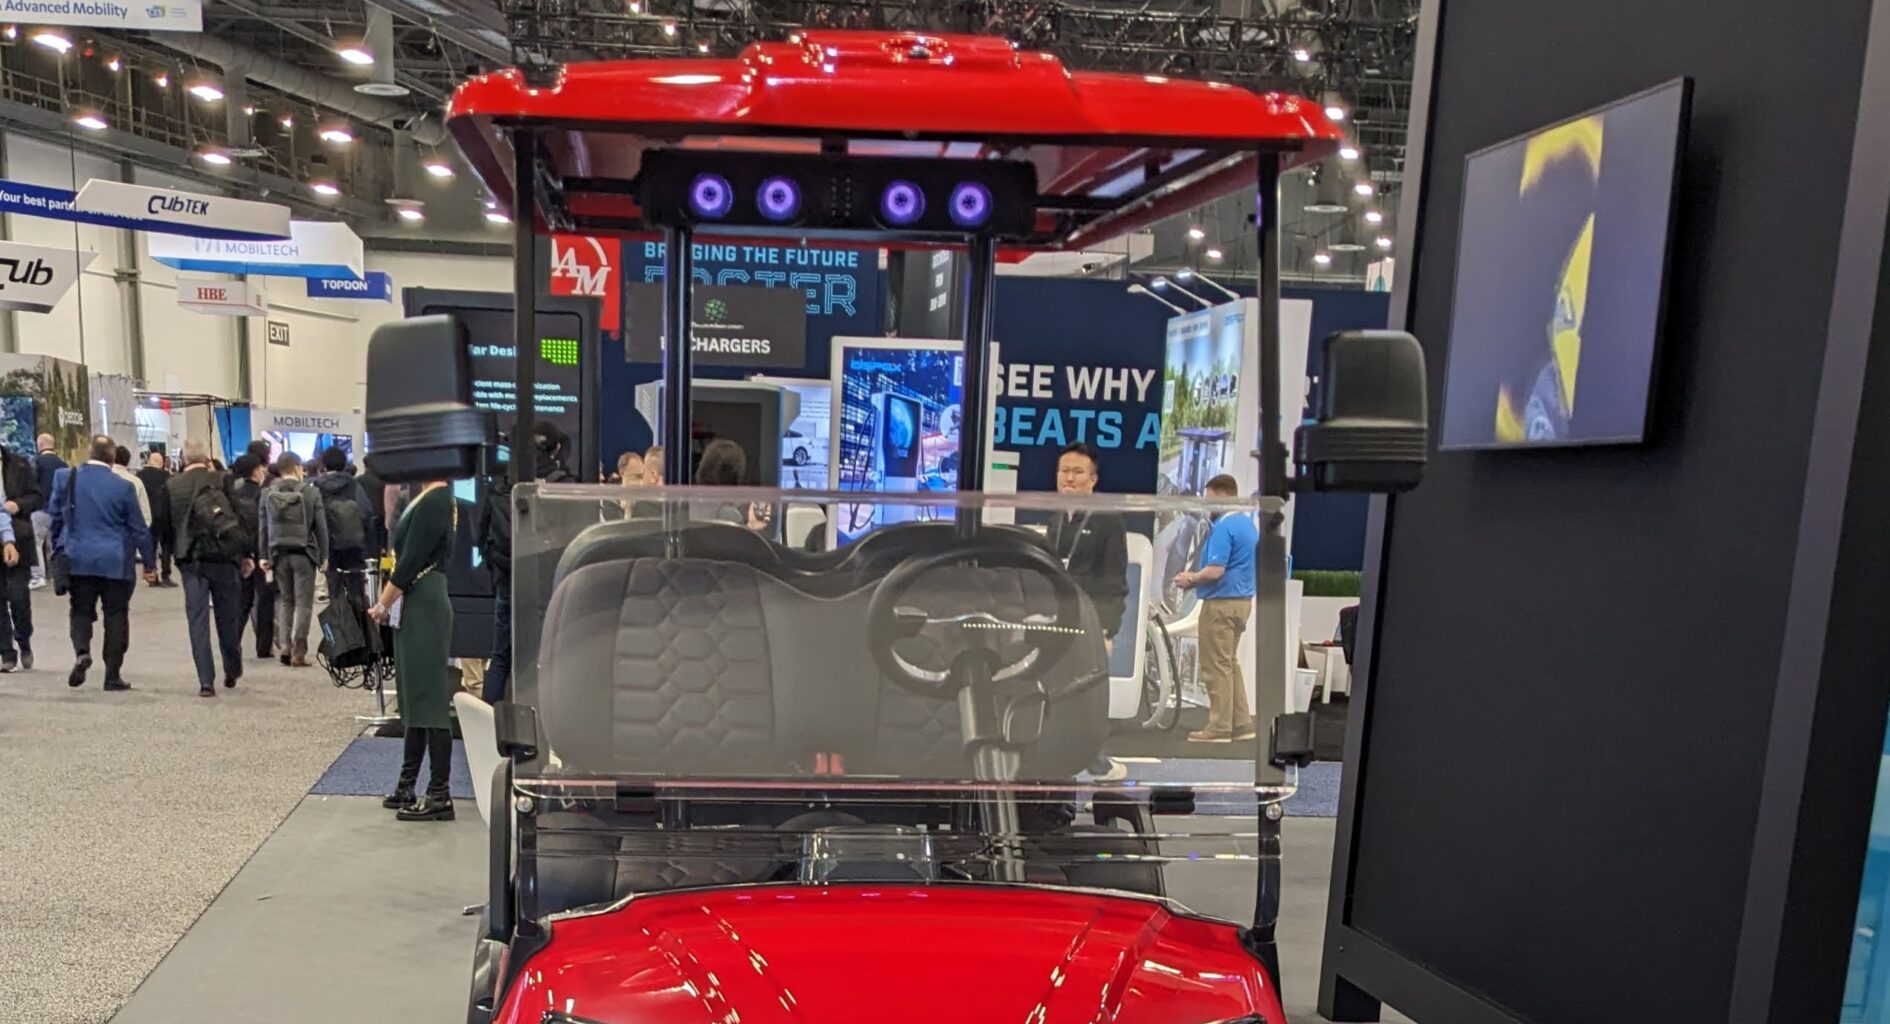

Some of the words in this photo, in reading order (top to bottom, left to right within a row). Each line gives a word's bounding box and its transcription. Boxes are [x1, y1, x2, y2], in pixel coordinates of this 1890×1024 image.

[5, 0, 70, 14] Advanced
[73, 3, 128, 19] Mobility
[0, 190, 21, 204] Your
[23, 193, 46, 208] best
[225, 242, 299, 256] MOBILTECH
[644, 241, 737, 262] BRGING
[743, 247, 778, 264] THE
[786, 249, 859, 267] FUTURE
[197, 287, 228, 300] HBE
[321, 279, 368, 291] TOPDON
[269, 324, 289, 342] EXIT
[1066, 366, 1156, 402] WHY
[273, 416, 339, 429] MOBILTECH
[993, 406, 1123, 448] BEATS
